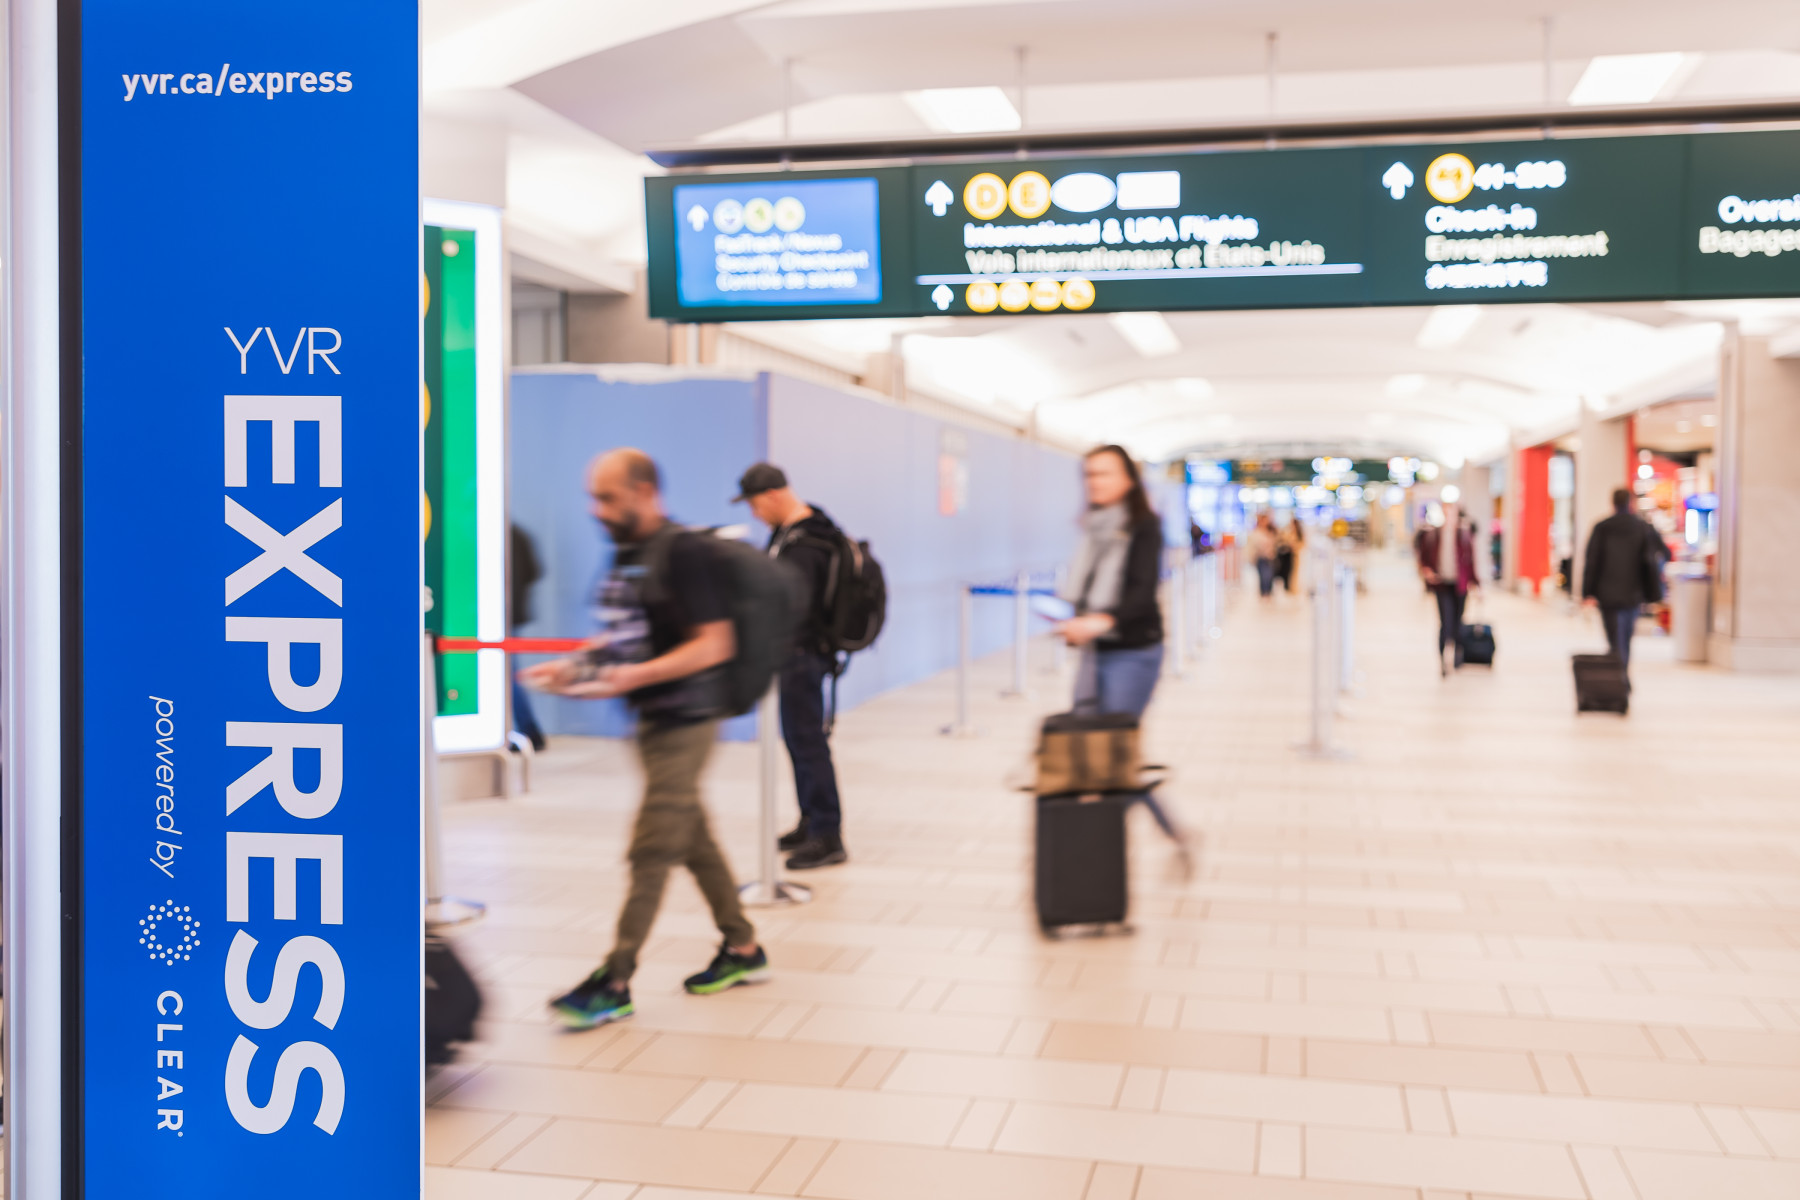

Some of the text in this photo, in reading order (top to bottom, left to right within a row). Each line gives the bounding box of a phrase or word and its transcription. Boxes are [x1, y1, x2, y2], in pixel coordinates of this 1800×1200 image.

[122, 63, 353, 102] yvr.ca/express
[224, 326, 343, 375] YVR
[149, 695, 183, 879] powered by
[224, 394, 346, 1136] EXPRESS
